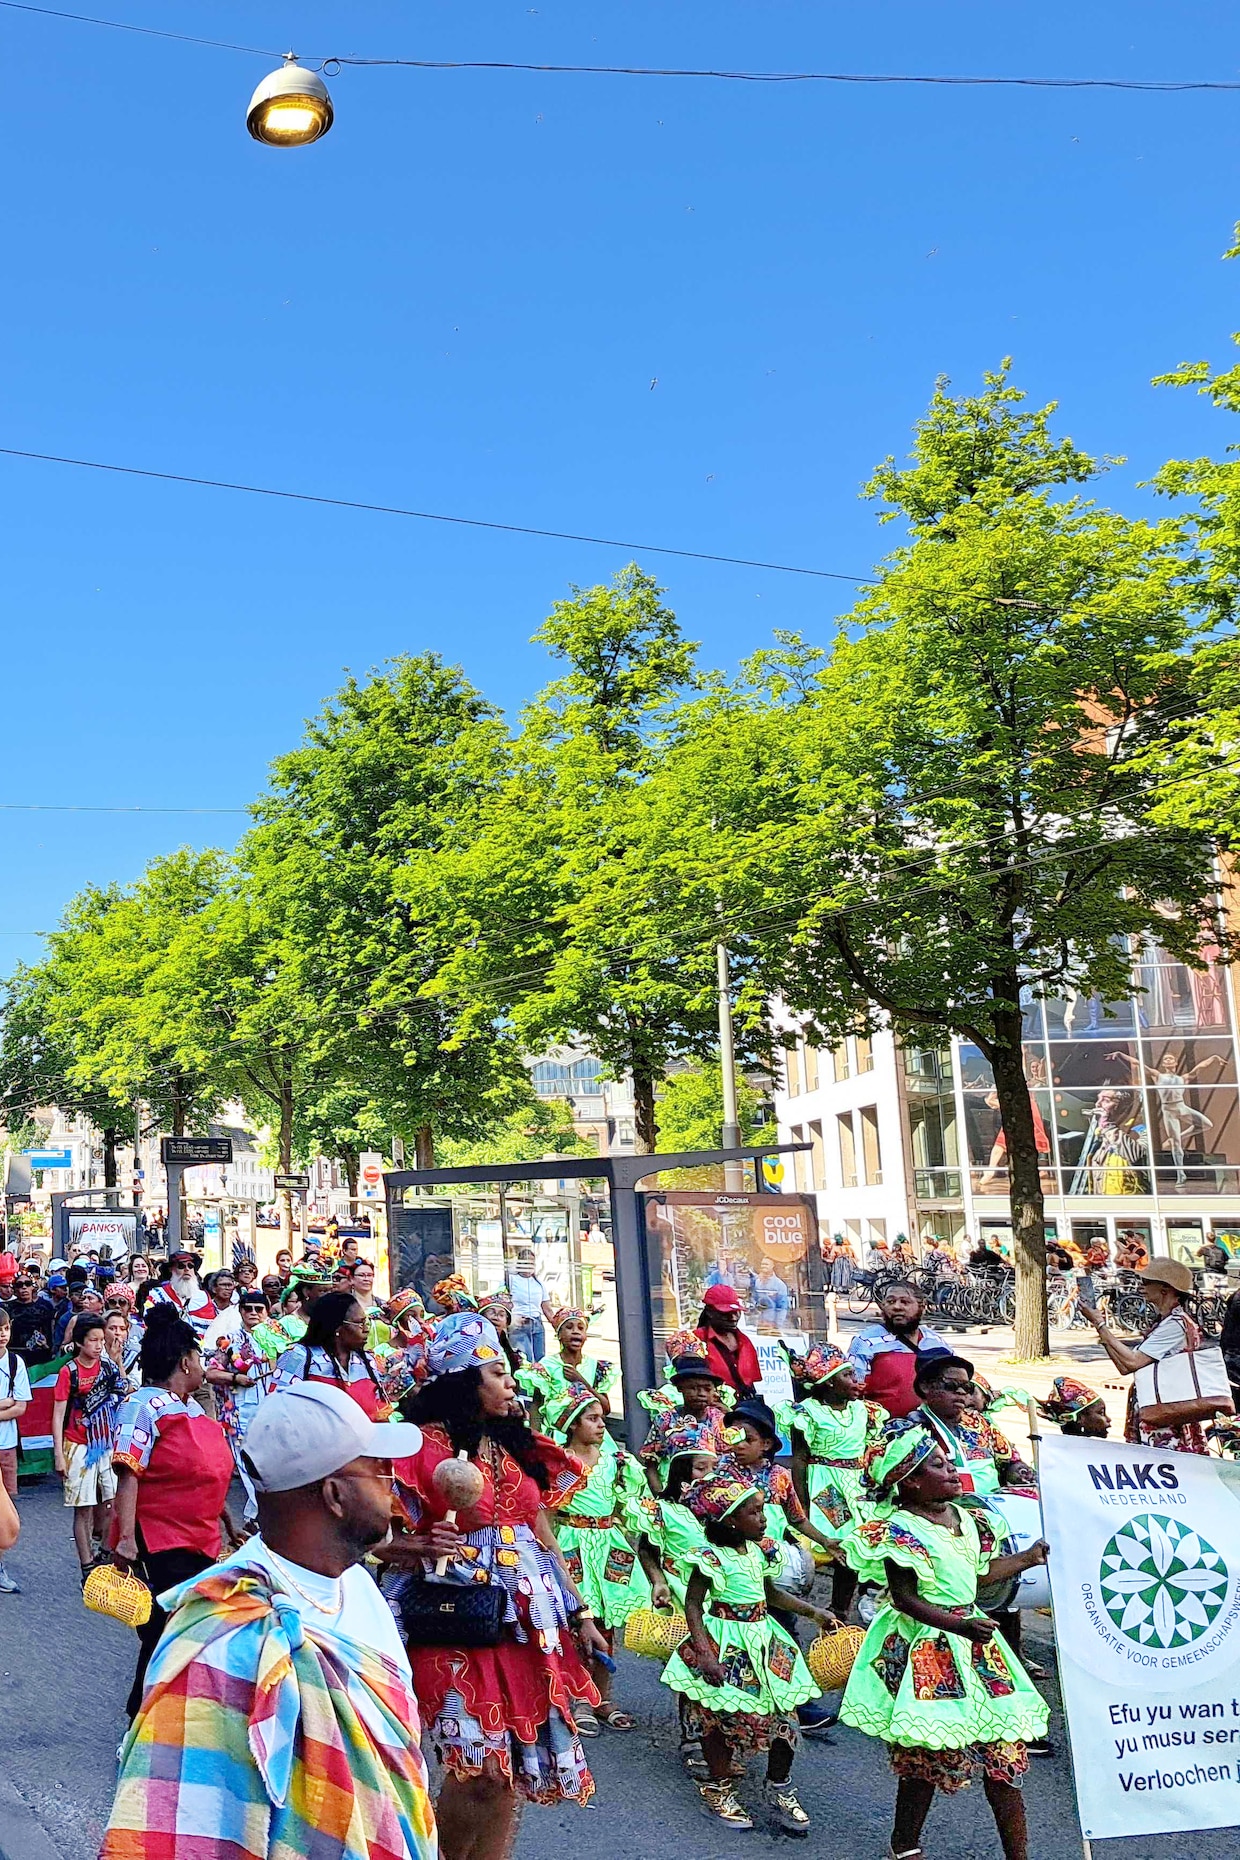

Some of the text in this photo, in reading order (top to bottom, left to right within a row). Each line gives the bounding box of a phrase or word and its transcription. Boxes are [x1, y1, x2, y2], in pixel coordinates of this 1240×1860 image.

[715, 1196, 750, 1204] JCDecaux
[82, 1223, 123, 1233] BANKSY
[763, 1213, 802, 1228] cool
[764, 1228, 803, 1244] blue
[1087, 1463, 1179, 1490] NAKS
[1099, 1493, 1187, 1506] NEDERLAND
[1081, 1583, 1123, 1655] ORGANISATIE
[1127, 1648, 1158, 1668] VOOR
[1108, 1703, 1141, 1725] Efu
[1146, 1705, 1172, 1726] yu
[1178, 1702, 1224, 1719] wan
[1114, 1737, 1139, 1760] yu
[1142, 1731, 1196, 1751] musu
[1118, 1763, 1231, 1792] Verloochen
